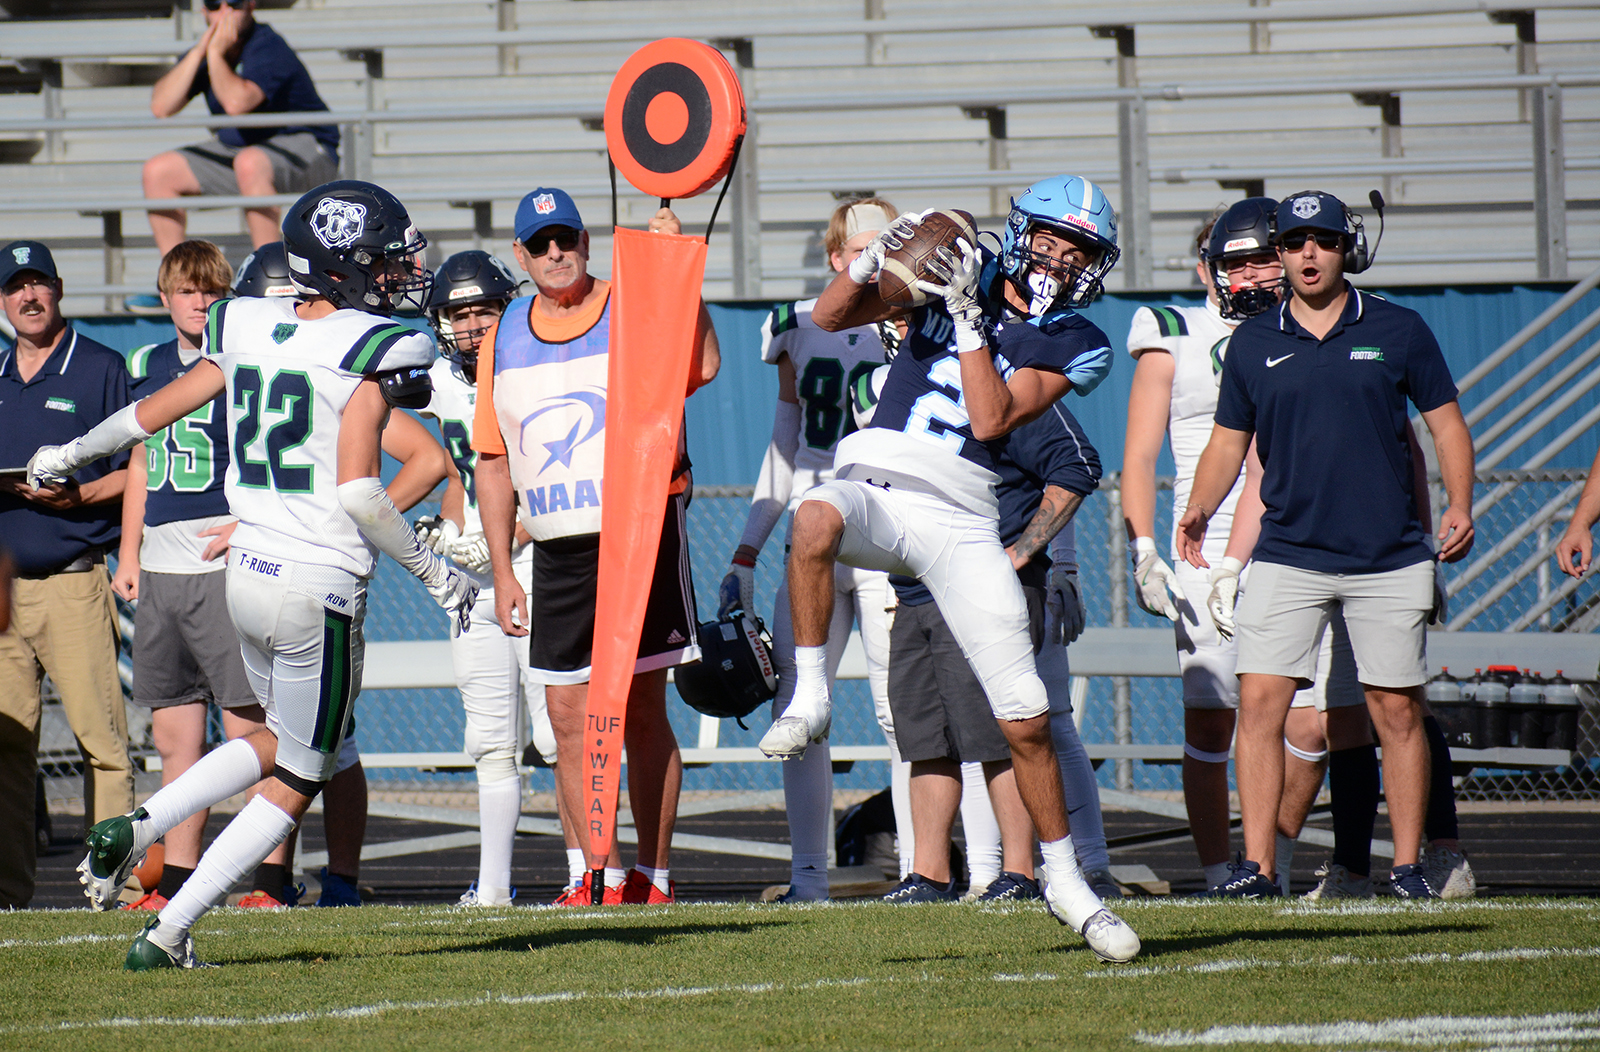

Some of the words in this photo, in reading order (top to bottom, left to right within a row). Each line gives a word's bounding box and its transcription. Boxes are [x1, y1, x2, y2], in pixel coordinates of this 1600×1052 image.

[537, 200, 555, 212] NFL
[1067, 214, 1096, 231] Riddell
[452, 286, 479, 297] Ridell
[1350, 351, 1385, 361] FOOTBALL
[233, 363, 315, 494] 22
[526, 478, 603, 517] NAA
[240, 553, 282, 577] T-RIDGE
[325, 592, 349, 608] ROW
[747, 629, 773, 677] Riddell
[588, 714, 620, 733] TUF
